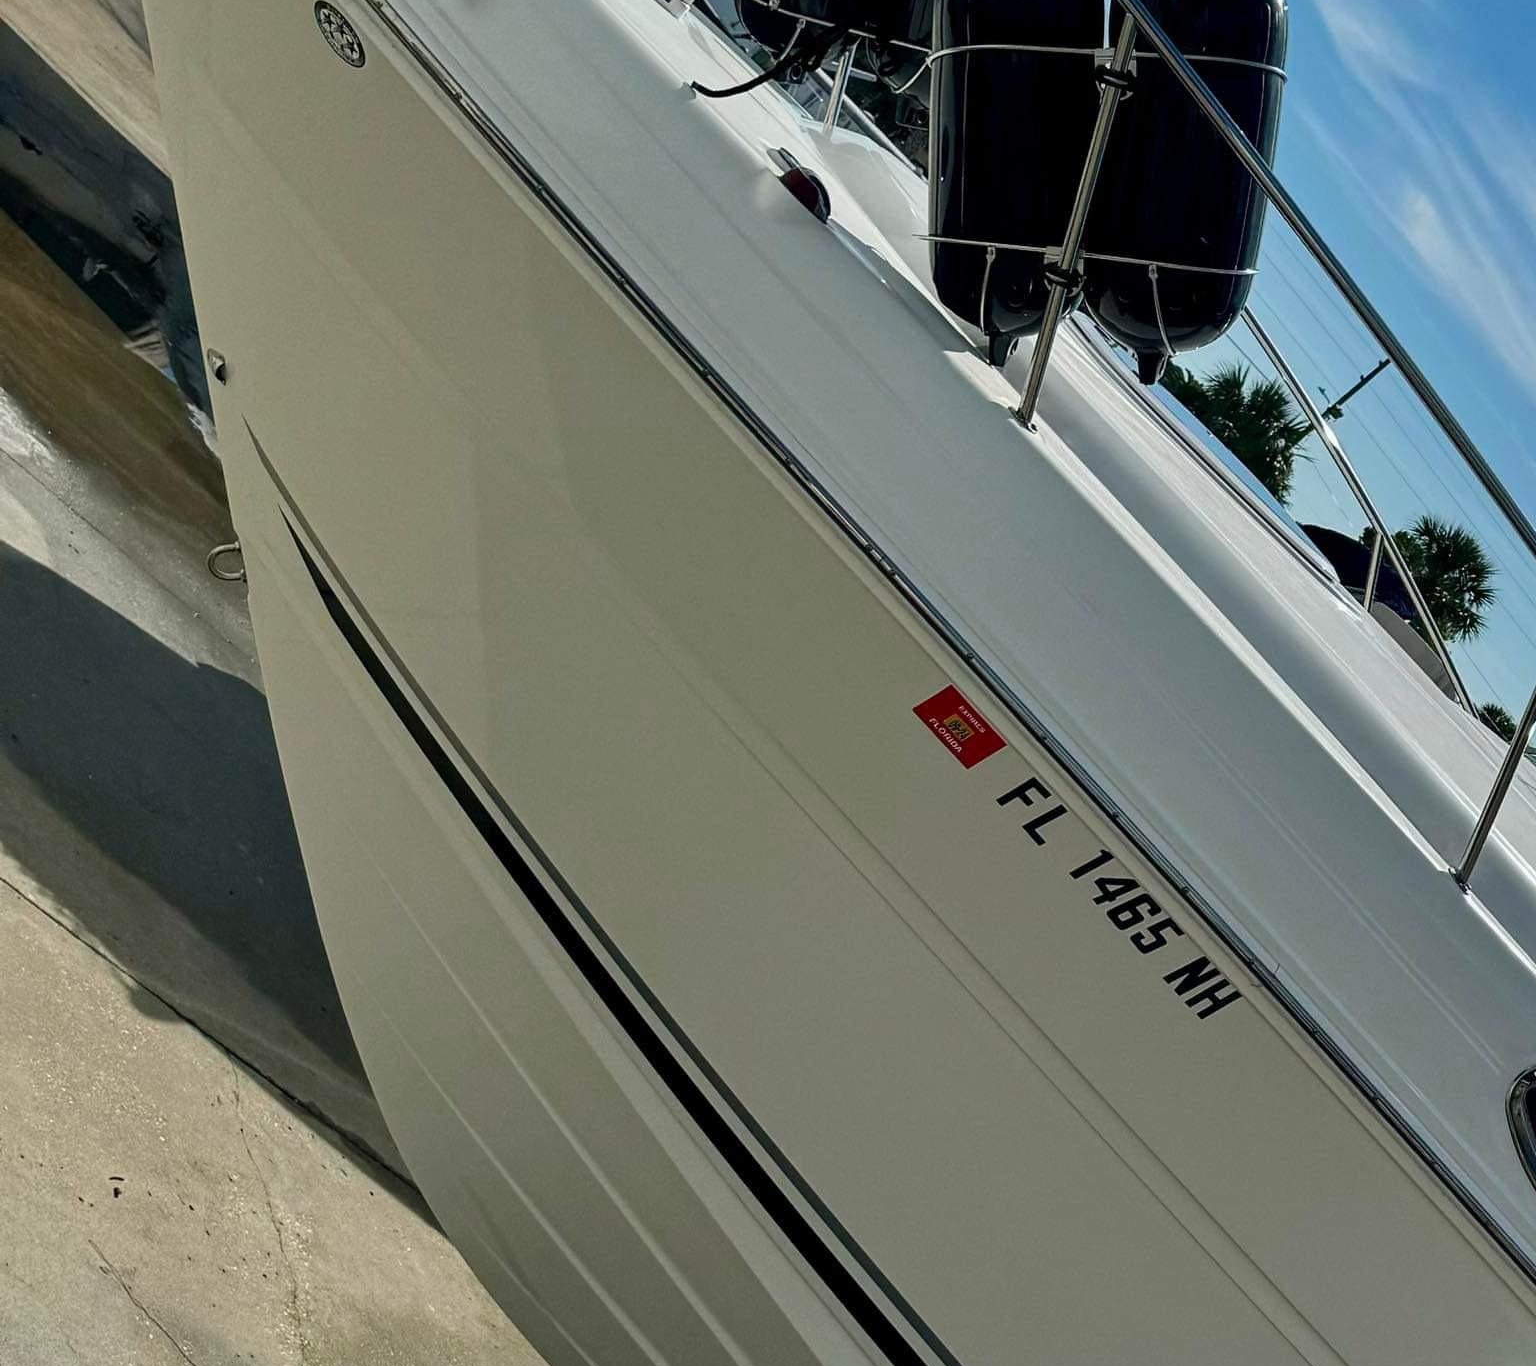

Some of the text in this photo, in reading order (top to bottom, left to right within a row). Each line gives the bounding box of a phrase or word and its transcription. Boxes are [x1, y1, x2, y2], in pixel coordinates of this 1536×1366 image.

[928, 717, 963, 753] FLORIDA
[958, 705, 986, 733] EXPIRES
[996, 777, 1242, 1020] FL 1465 NH
